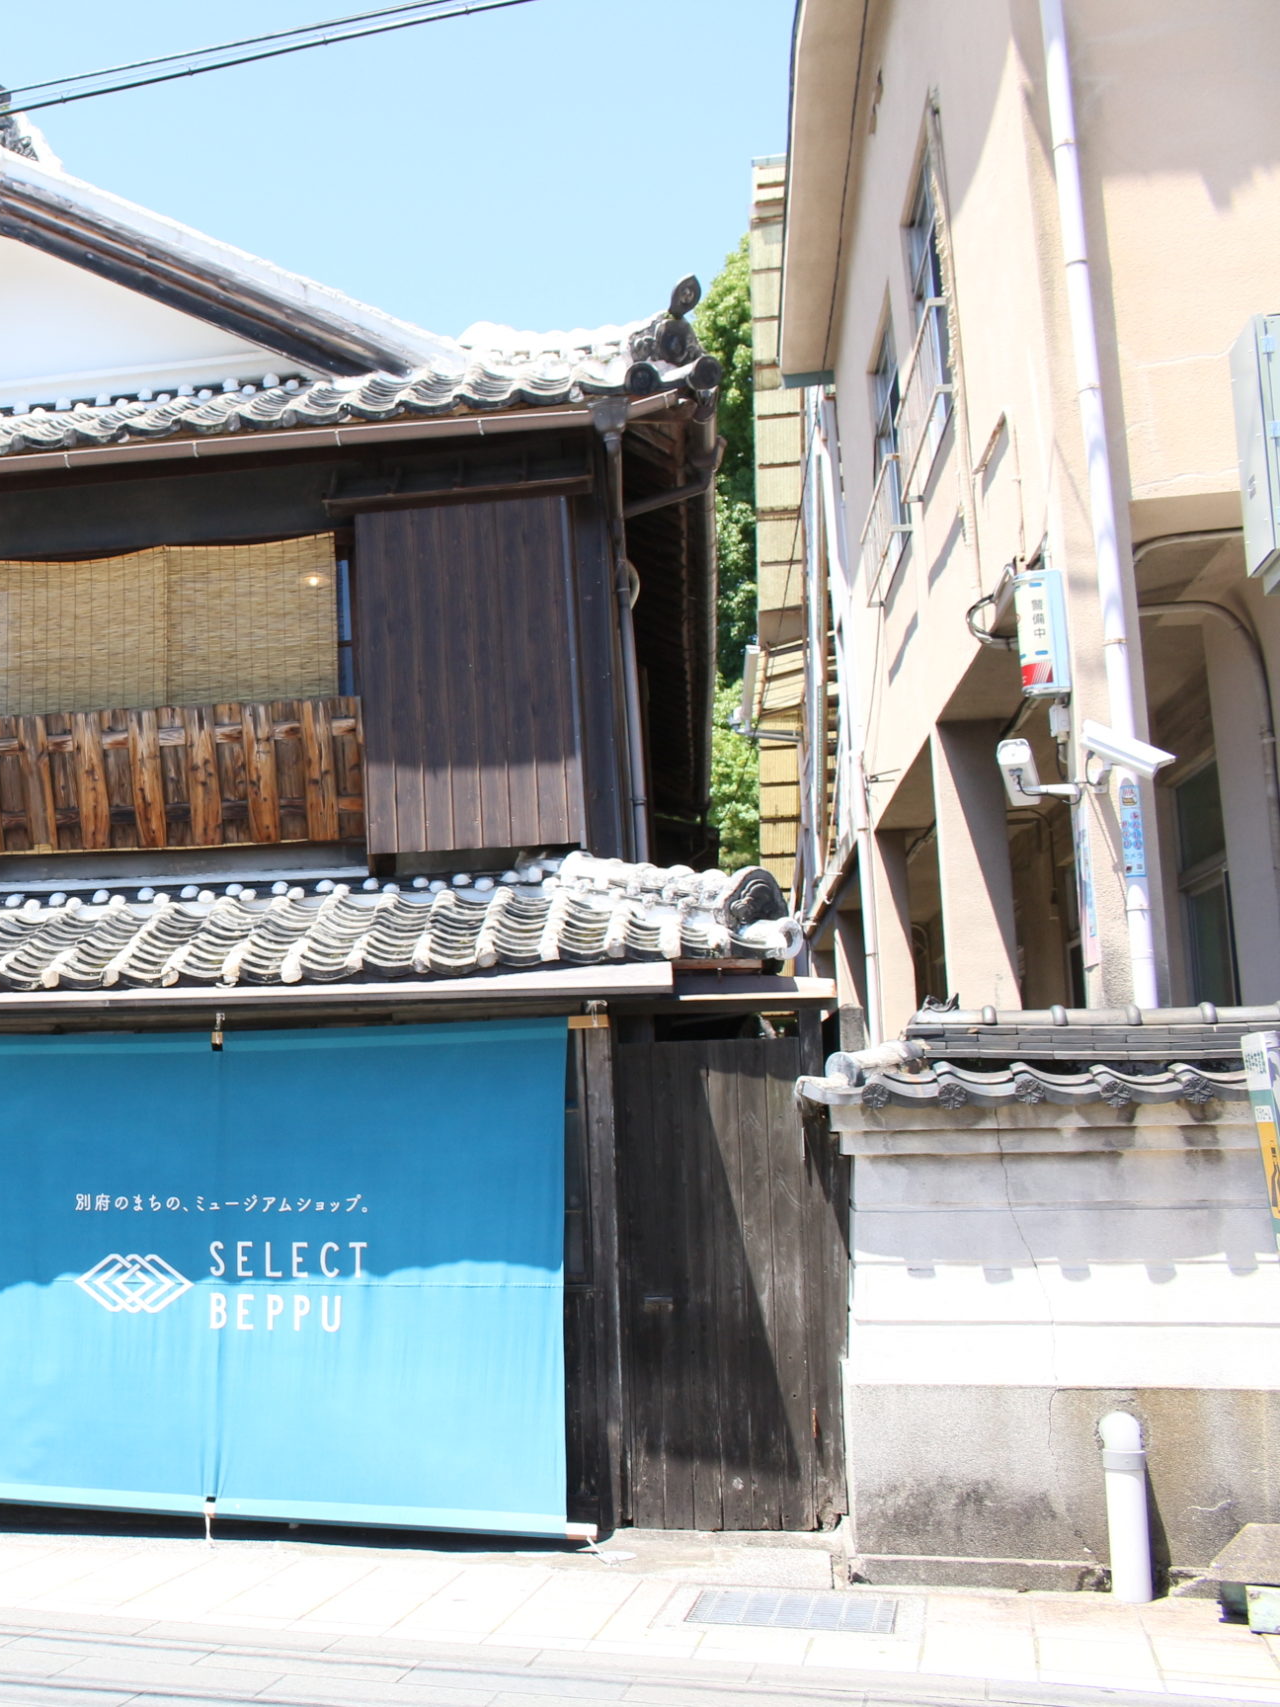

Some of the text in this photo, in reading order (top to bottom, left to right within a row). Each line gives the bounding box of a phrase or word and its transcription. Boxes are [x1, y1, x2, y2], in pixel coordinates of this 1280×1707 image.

[74, 1193, 369, 1214] 別府のまちの、ミュージアムショップ。
[209, 1241, 368, 1279] SELECT
[209, 1292, 342, 1333] BEPPU
